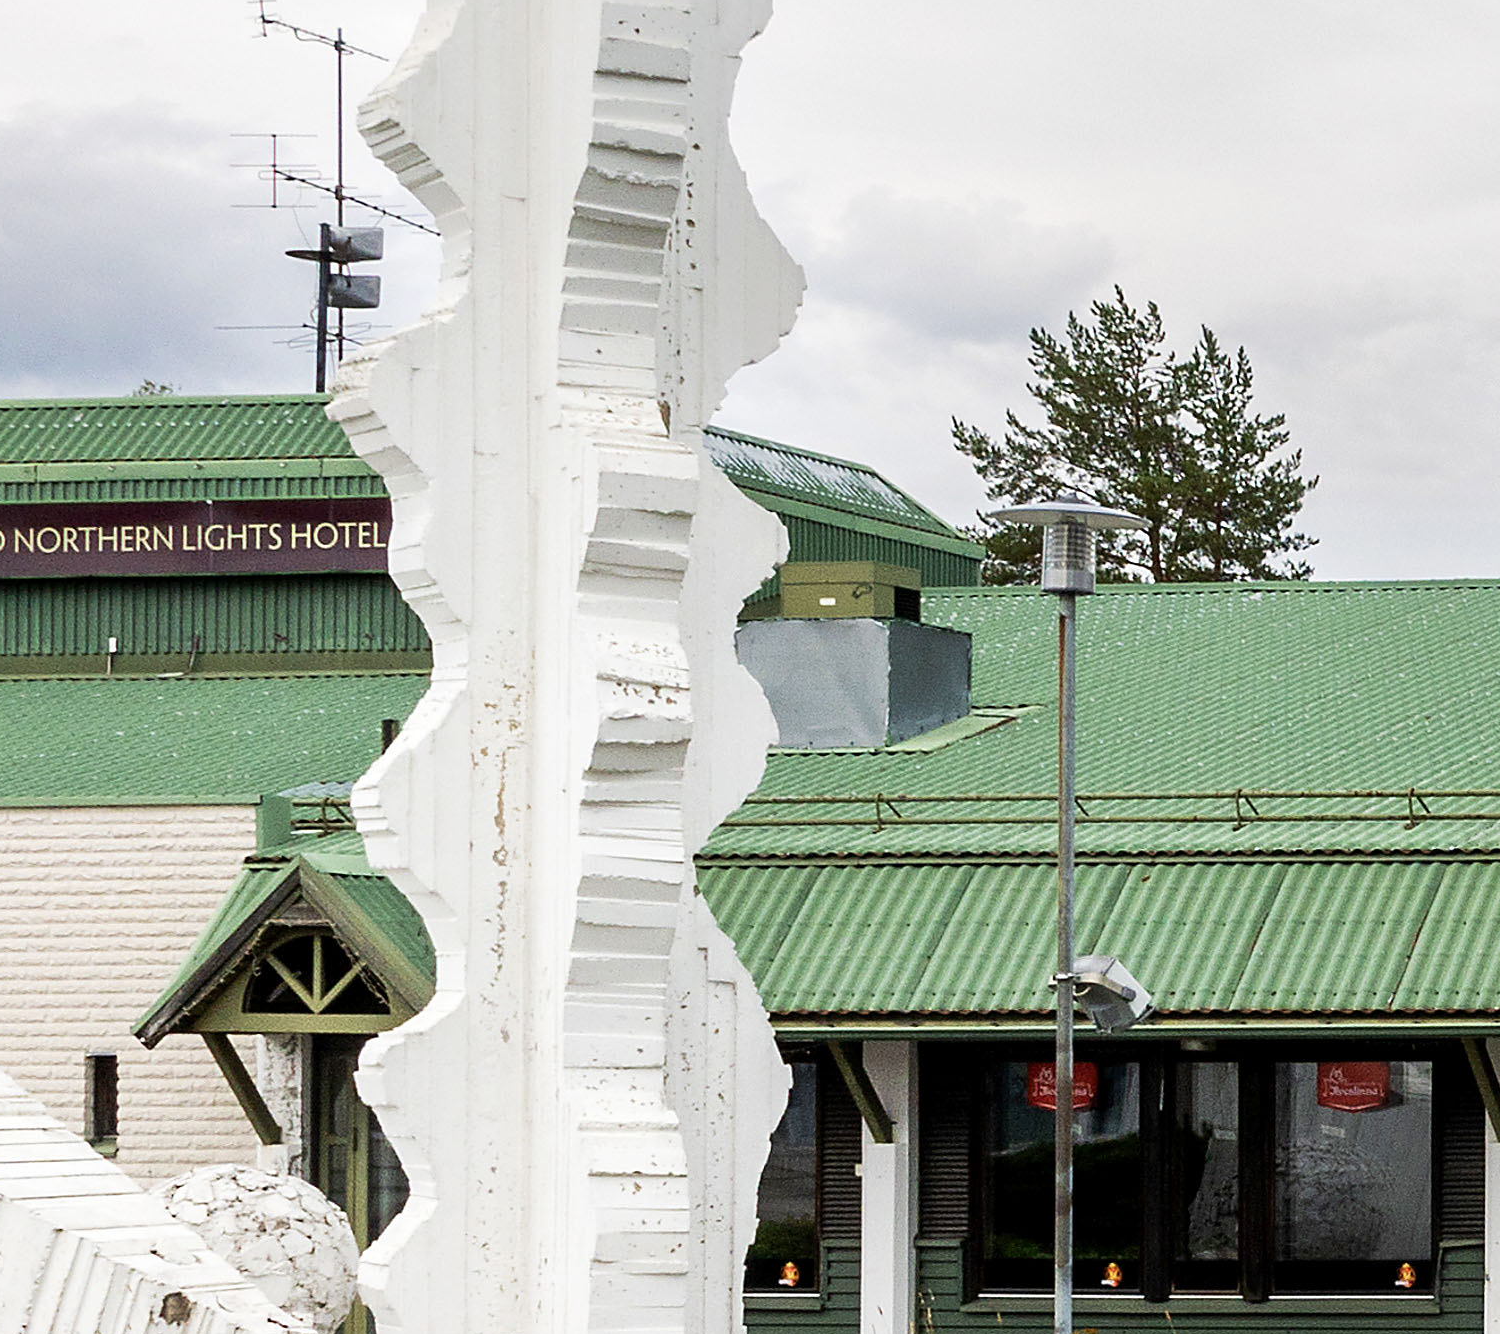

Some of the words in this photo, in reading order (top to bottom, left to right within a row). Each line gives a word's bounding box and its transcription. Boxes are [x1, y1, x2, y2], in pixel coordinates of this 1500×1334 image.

[14, 525, 174, 553] NORTHERN
[181, 523, 283, 552] LIGHTS
[290, 521, 388, 549] HOTEL
